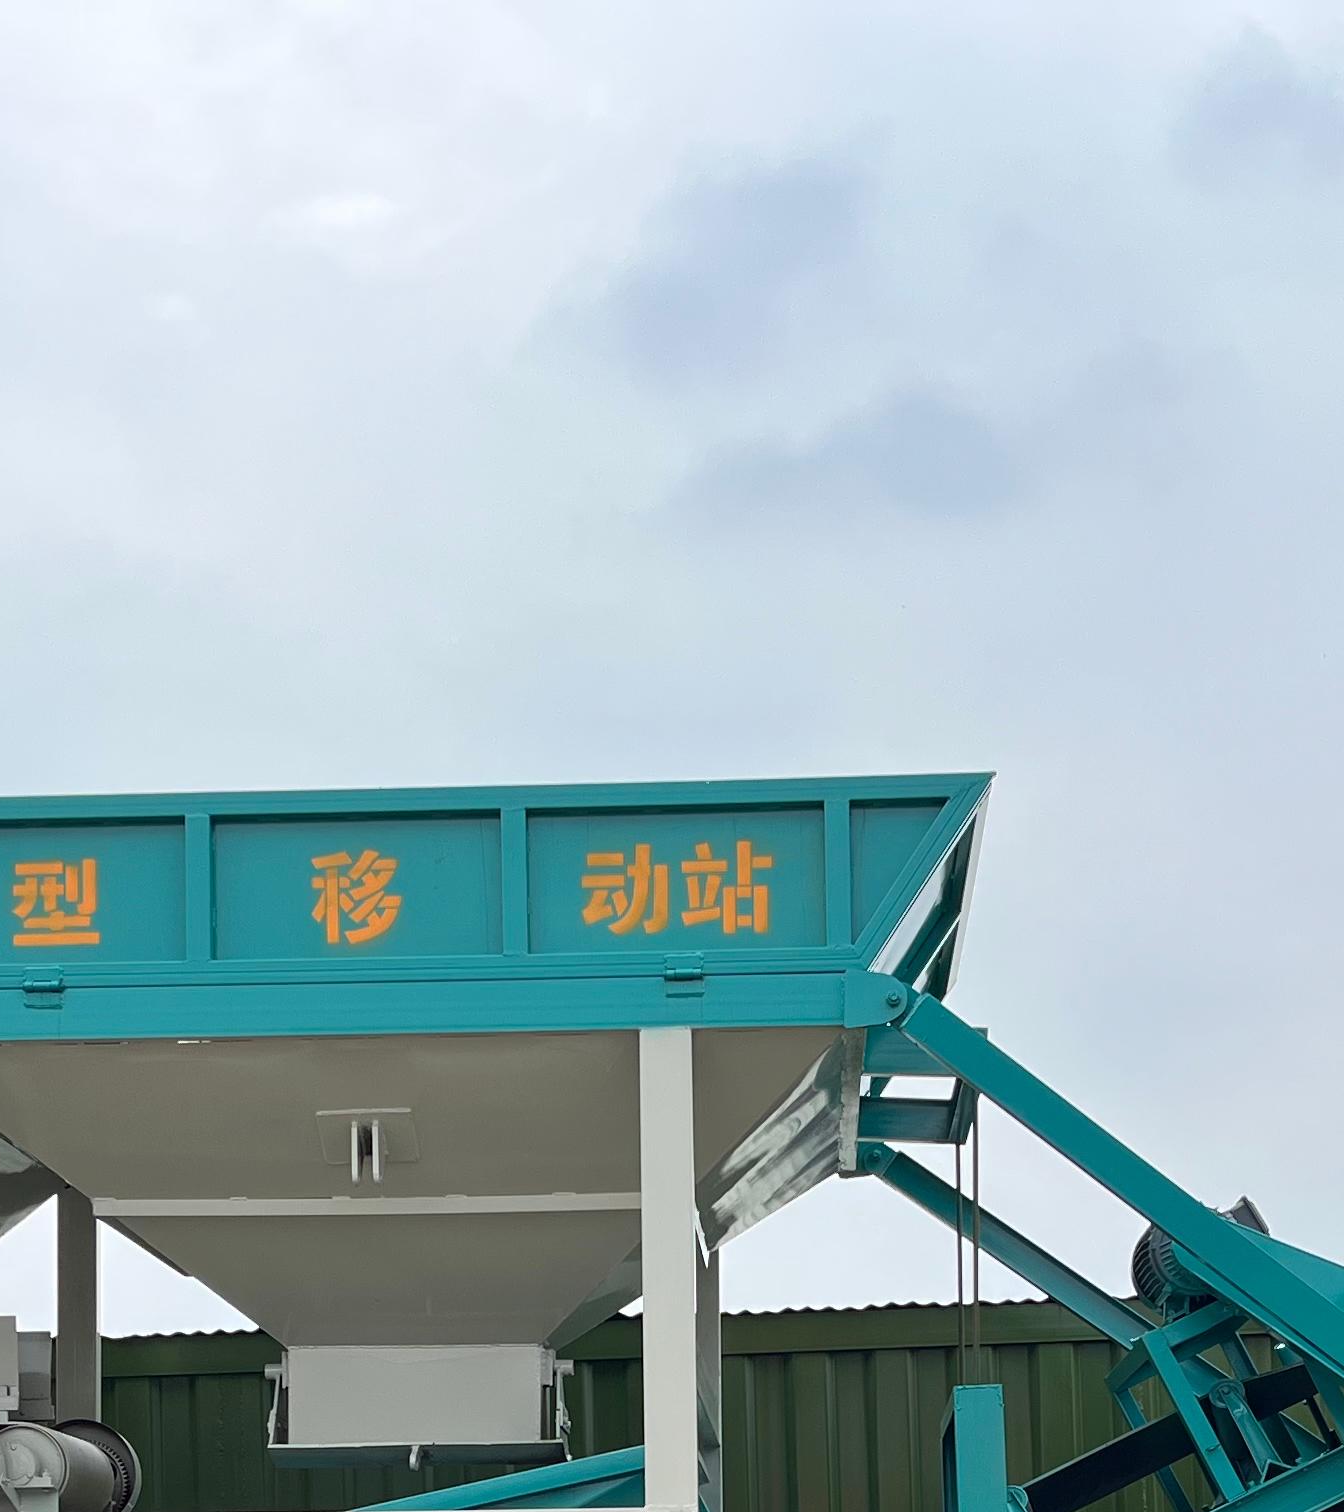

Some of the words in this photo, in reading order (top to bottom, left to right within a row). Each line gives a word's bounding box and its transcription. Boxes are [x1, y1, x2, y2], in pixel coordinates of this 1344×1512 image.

[11, 858, 101, 946] 型
[310, 848, 403, 946] 移
[581, 840, 774, 936] 动站
